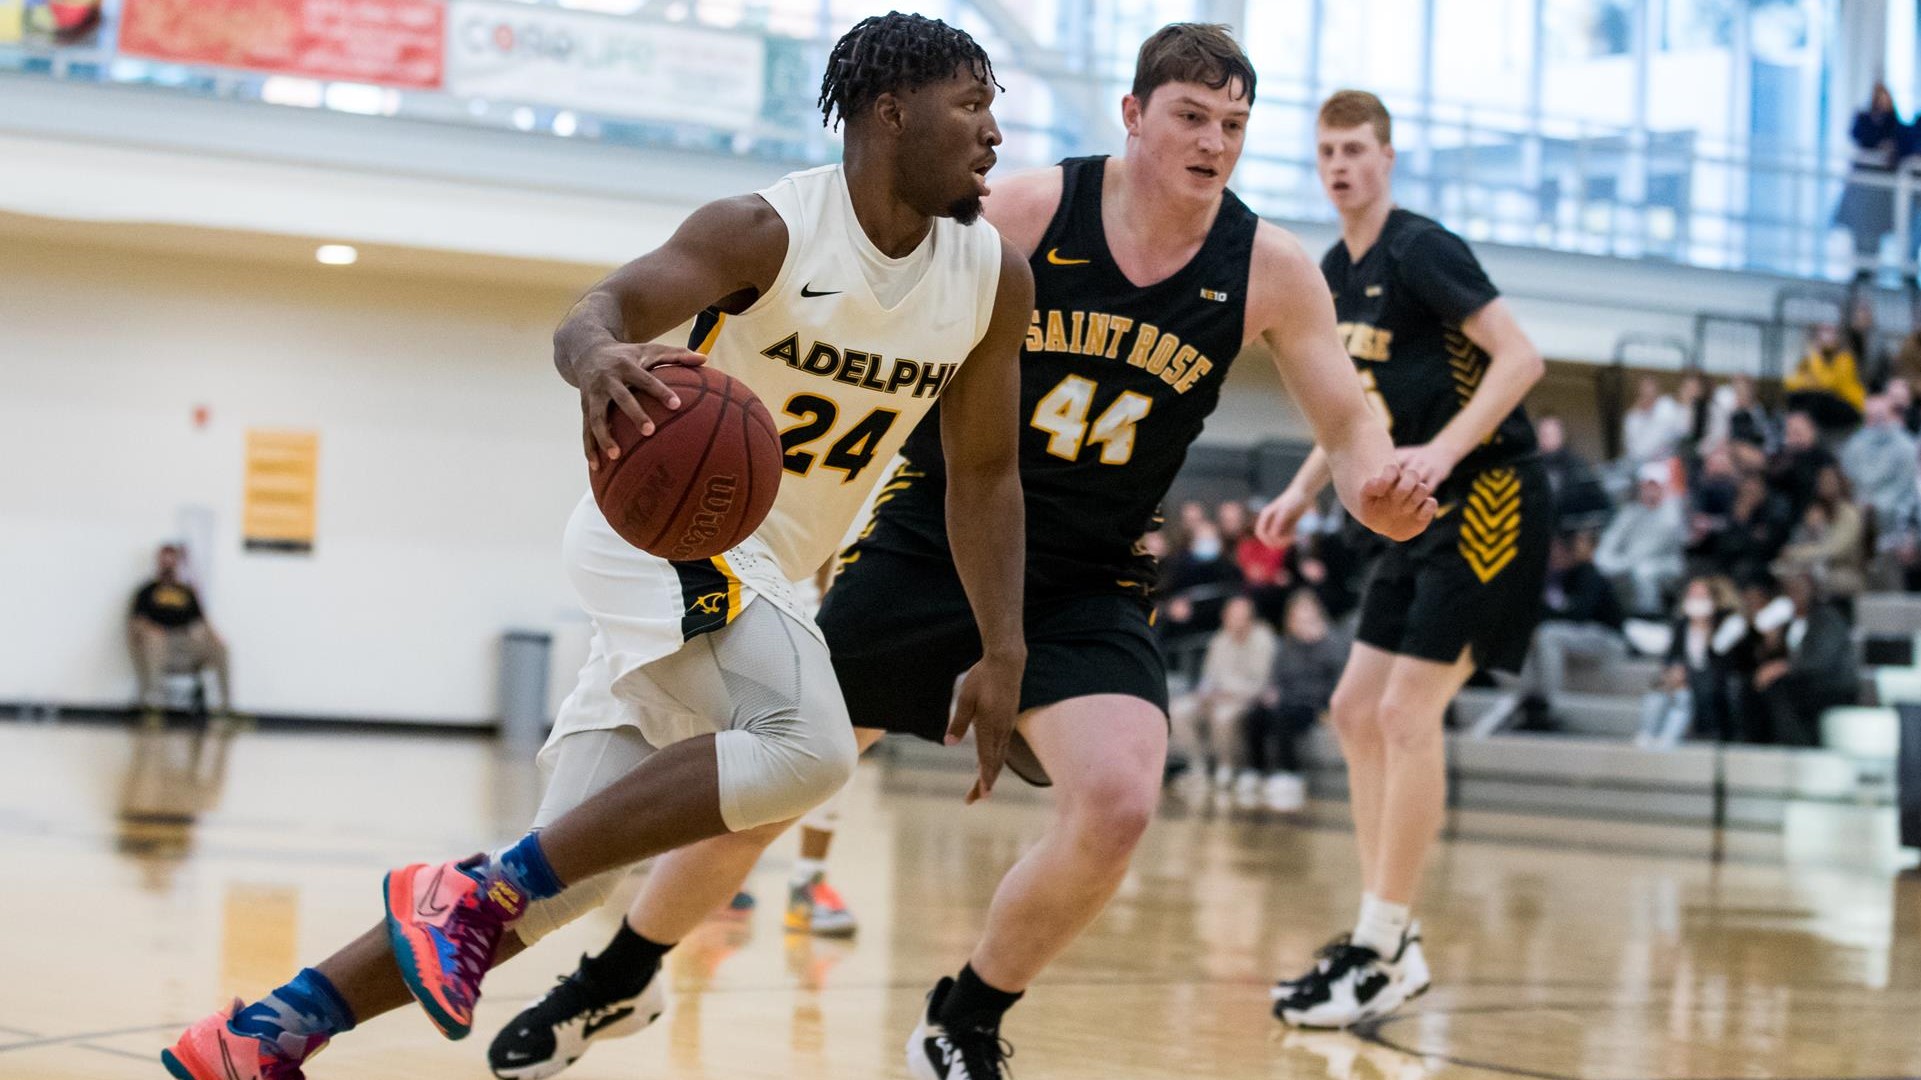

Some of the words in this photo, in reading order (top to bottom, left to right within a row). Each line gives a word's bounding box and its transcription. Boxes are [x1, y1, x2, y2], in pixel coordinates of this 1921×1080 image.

[1025, 309, 1134, 359] SAINT
[1126, 323, 1213, 395] ROSE
[779, 391, 902, 484] 24
[1030, 373, 1153, 465] 44
[671, 473, 739, 560] Wilso
